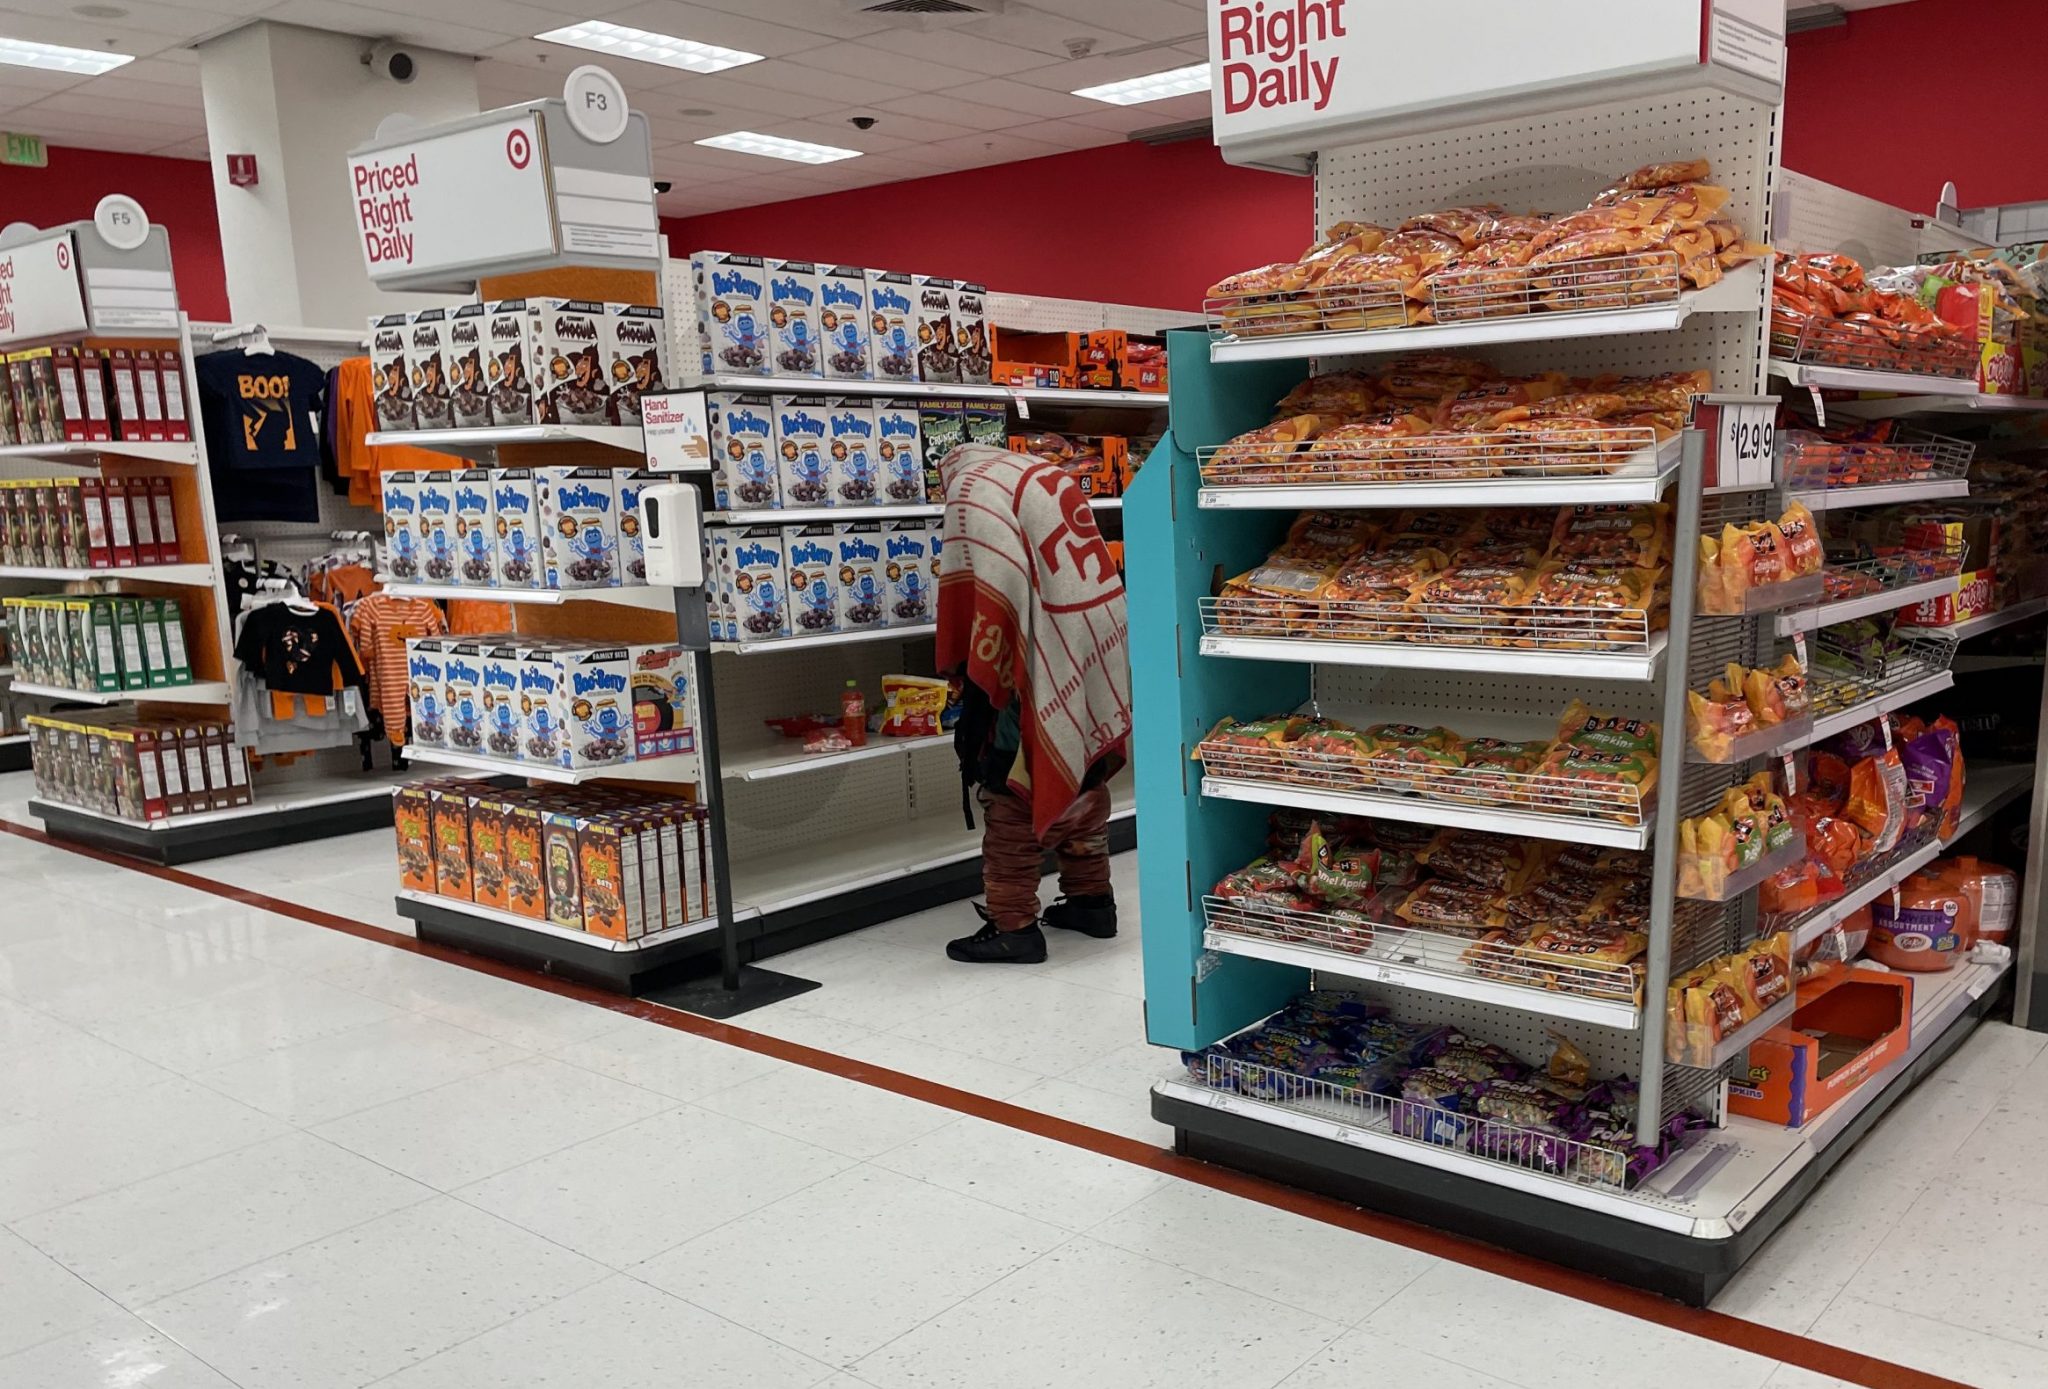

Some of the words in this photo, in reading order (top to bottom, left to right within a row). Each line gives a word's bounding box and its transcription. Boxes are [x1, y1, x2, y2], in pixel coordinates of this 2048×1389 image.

[1221, 0, 1346, 62] Right
[1223, 49, 1339, 115] Daily
[586, 91, 607, 111] F3
[7, 132, 41, 163] EXIT
[354, 153, 419, 197] Priced
[112, 212, 130, 225] F5
[360, 192, 413, 234] Right
[365, 227, 414, 264] Daily
[1049, 370, 1059, 382] 110
[238, 375, 289, 398] BOO!
[644, 398, 668, 411] Hand
[920, 402, 944, 410] FAMILY
[966, 402, 989, 410] FAMILY
[646, 412, 684, 424] Sanitizer
[928, 432, 958, 446] CRUNCH
[1731, 422, 1772, 459] $2.99
[1082, 478, 1091, 488] 60
[1340, 878, 1367, 889] Apple
